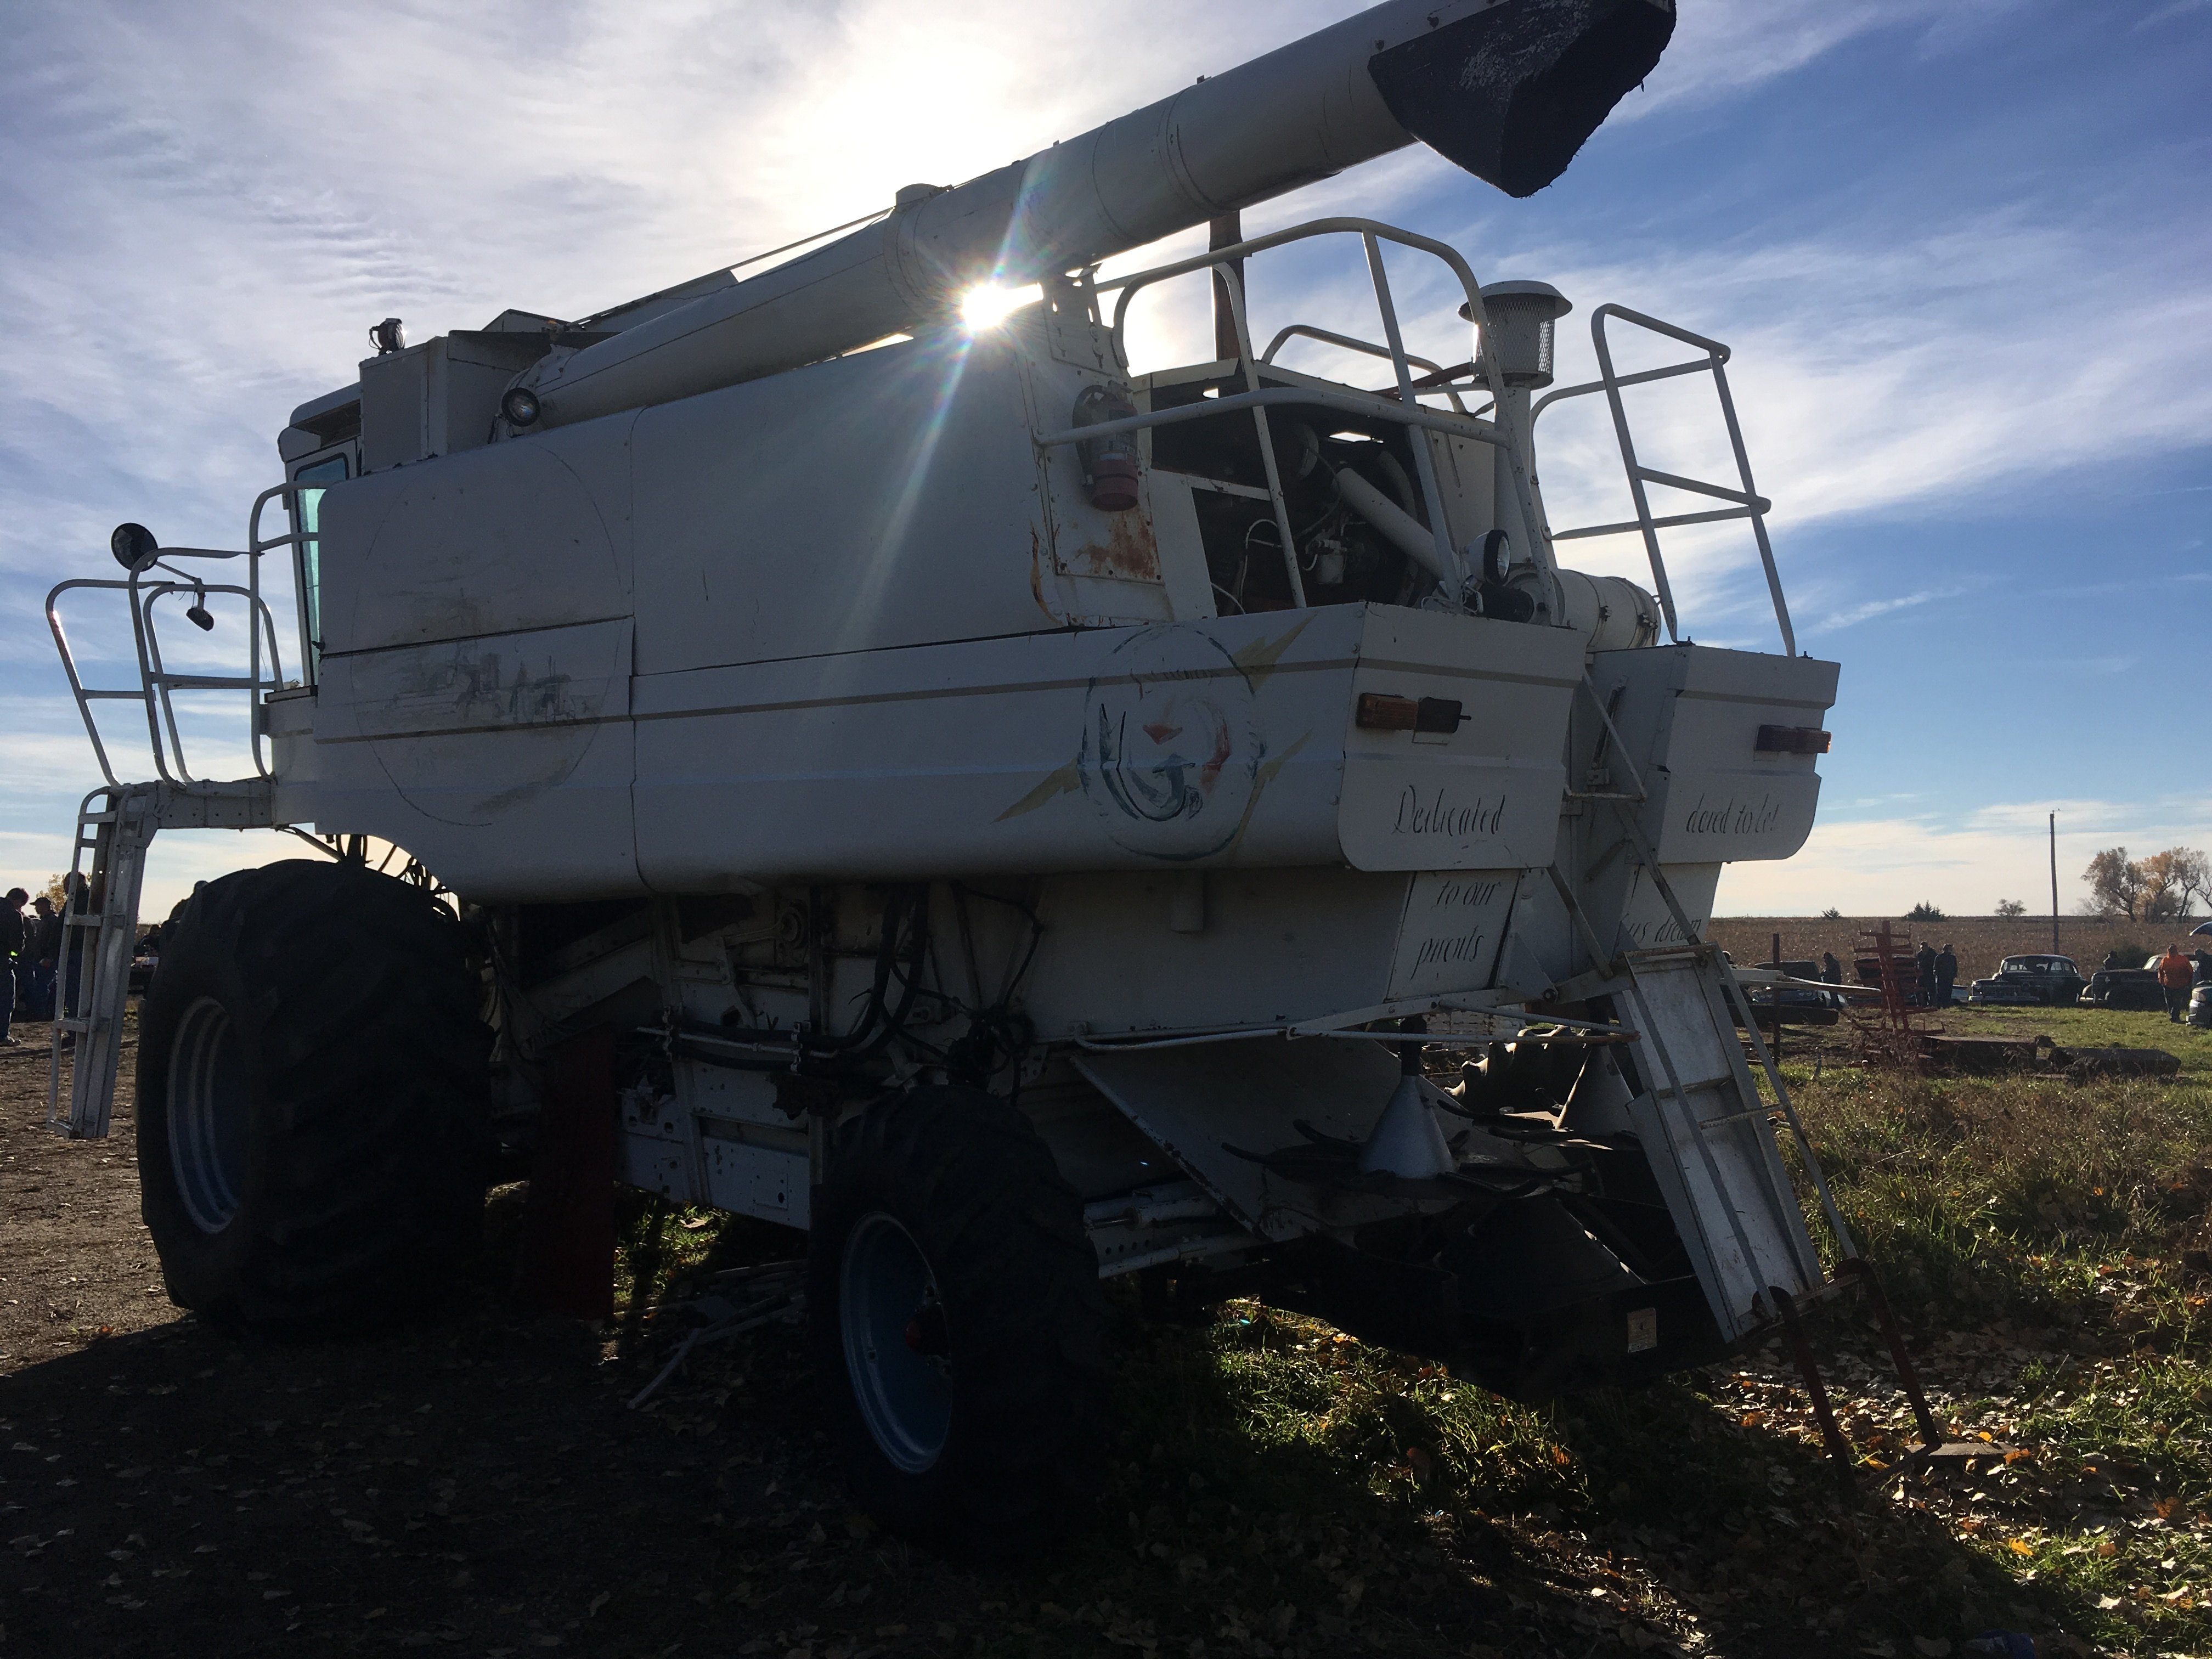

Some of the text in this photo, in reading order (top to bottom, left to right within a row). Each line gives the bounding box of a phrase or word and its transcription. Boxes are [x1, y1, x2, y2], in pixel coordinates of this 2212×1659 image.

[1391, 785, 1505, 836] Dedicated
[1735, 804, 1753, 834] to
[1431, 881, 1502, 909] to our
